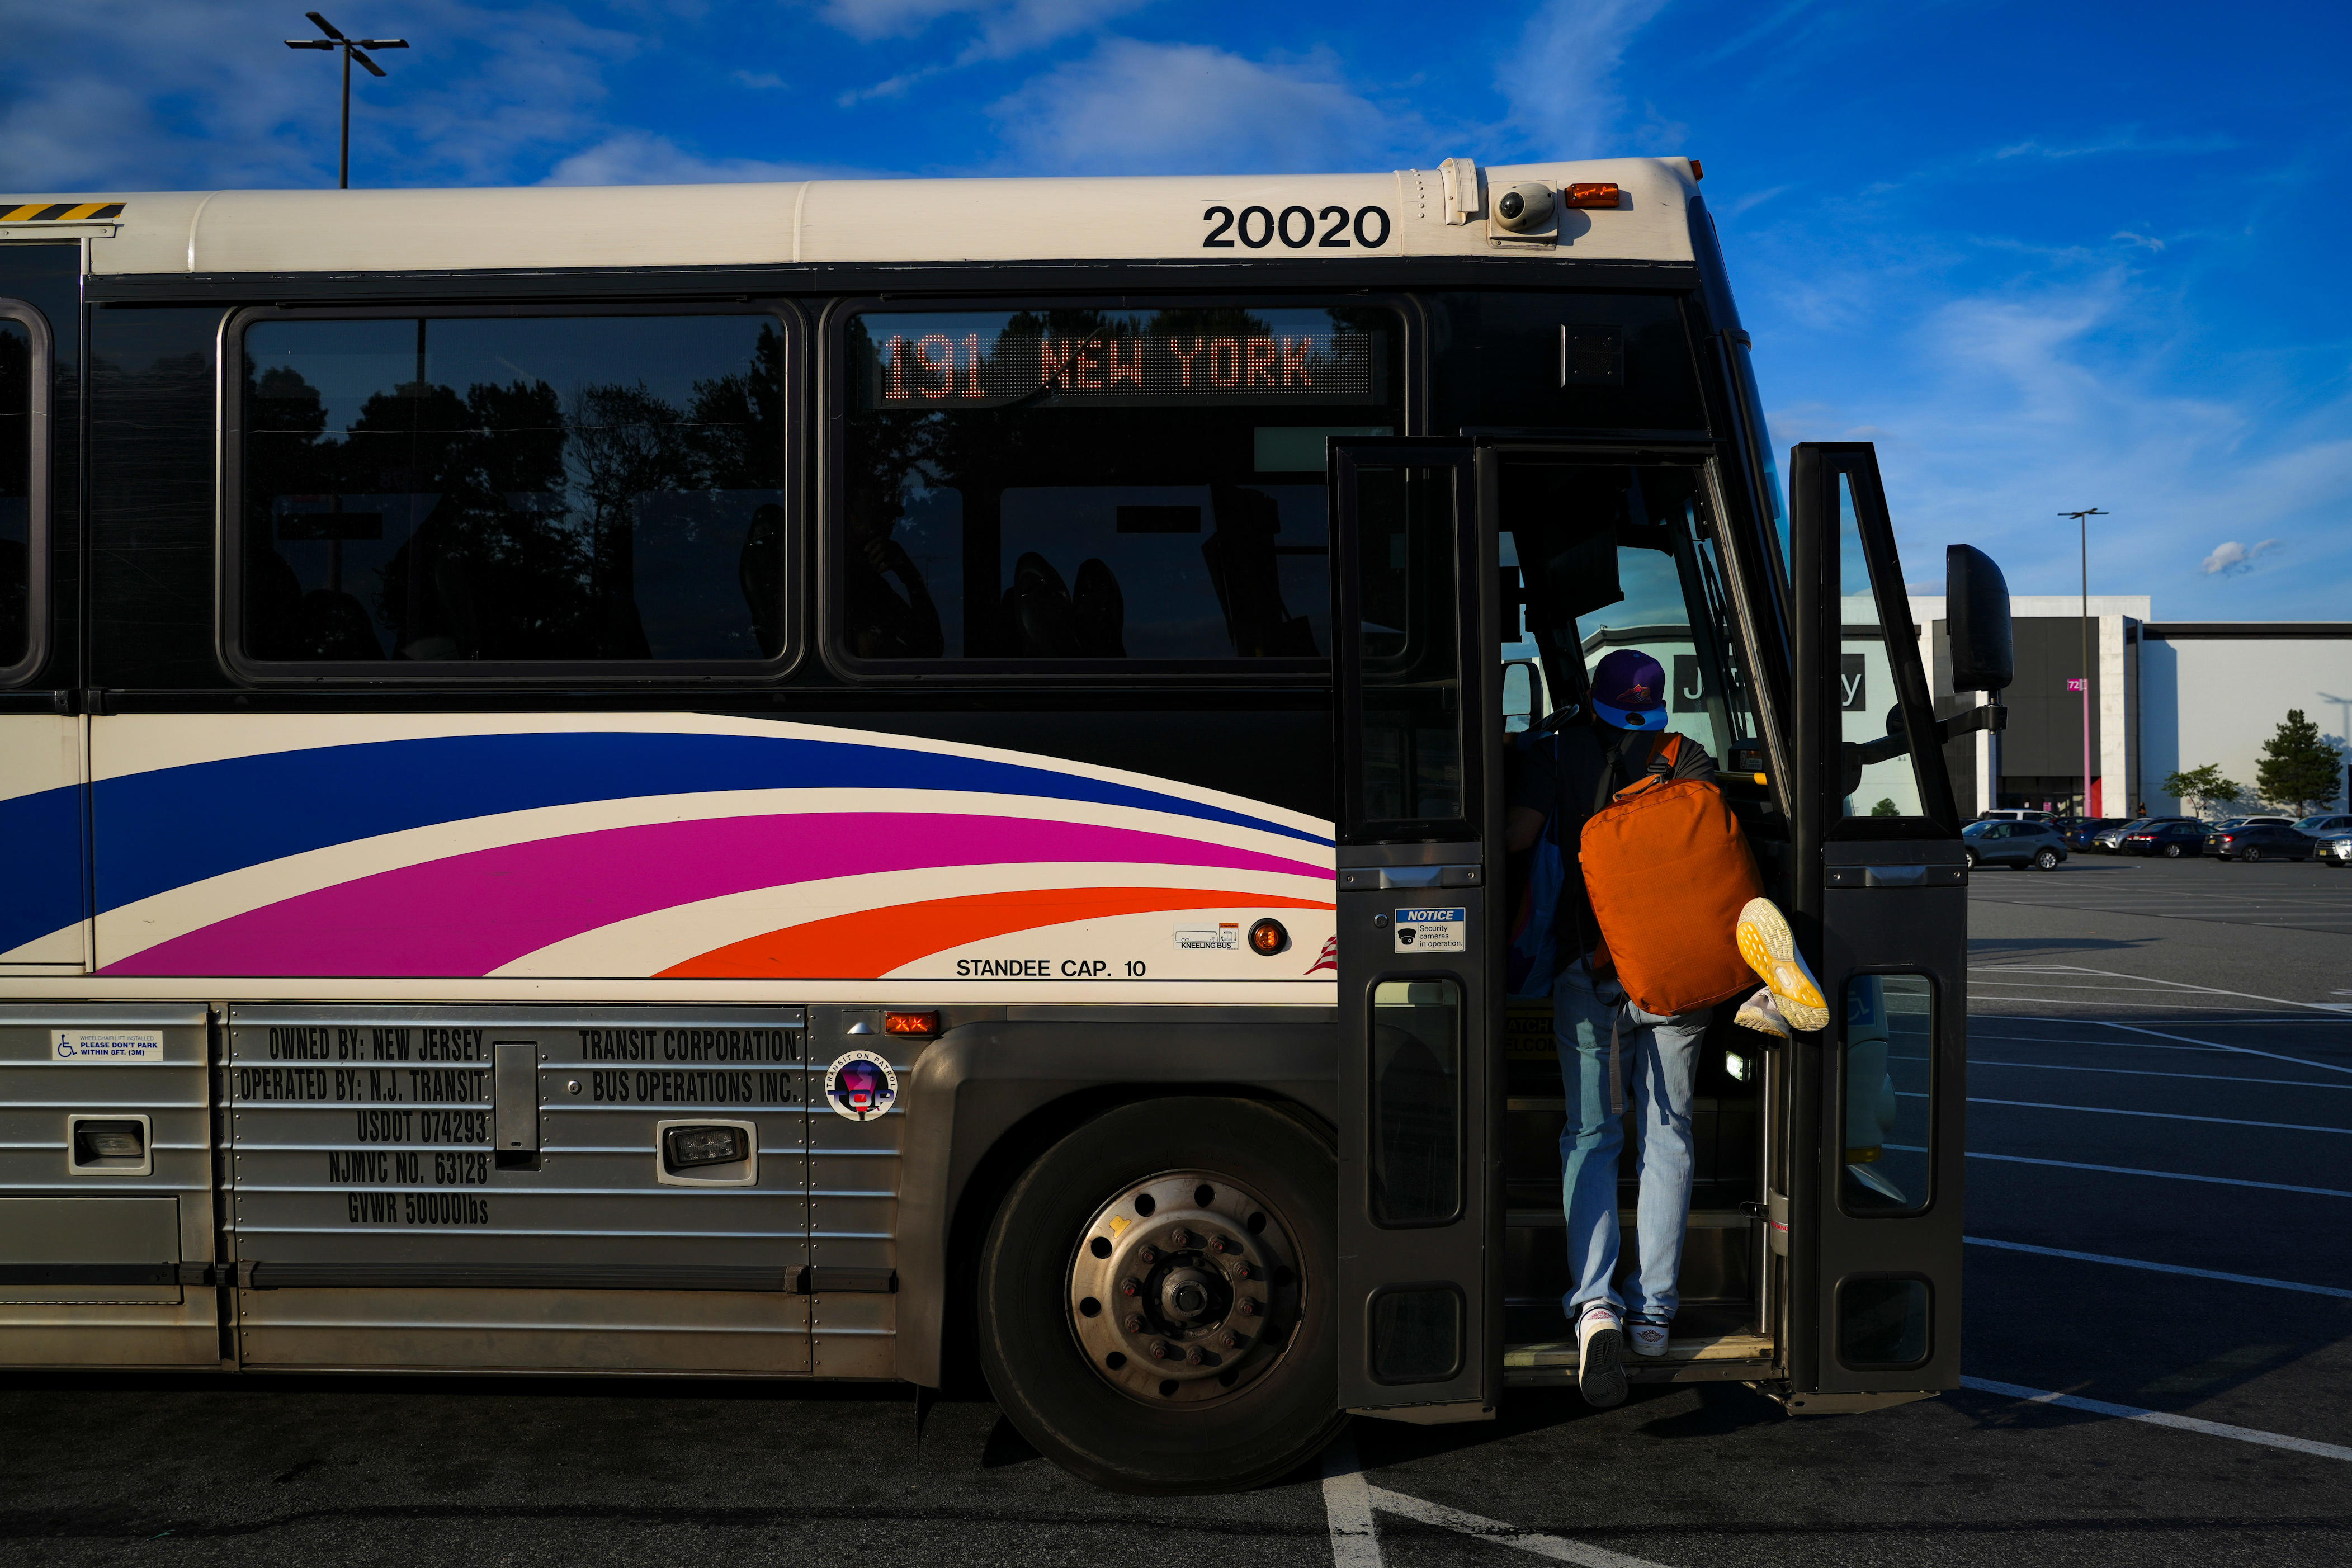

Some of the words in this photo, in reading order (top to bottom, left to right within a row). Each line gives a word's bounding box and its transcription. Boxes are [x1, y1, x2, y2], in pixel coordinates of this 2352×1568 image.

[1203, 205, 1391, 249] 20020
[885, 333, 985, 399] 191
[1041, 339, 1143, 388] NEW
[1169, 337, 1313, 388] YORK
[2068, 681, 2079, 689] 72
[1407, 910, 1454, 921] NOTICE
[1428, 940, 1463, 948] operation.
[956, 959, 1051, 976] STANDEE
[1060, 960, 1112, 977] CAP.
[1124, 960, 1146, 977] 10
[1507, 1019, 1548, 1034] ATCH
[269, 1027, 330, 1060] OWNED
[338, 1028, 365, 1060] BY:
[372, 1028, 410, 1061] NEW
[418, 1029, 483, 1061] JERSEY
[579, 1029, 656, 1061] TRANSIT
[663, 1029, 797, 1062] CORPORATION
[240, 1068, 327, 1101] OPERATED
[336, 1069, 362, 1101] BY:
[370, 1069, 403, 1102] N.J.
[409, 1070, 485, 1102] TRANSIT
[593, 1071, 630, 1102] BUS
[636, 1071, 754, 1103] OPERATIONS
[761, 1071, 798, 1103] INC.
[826, 1055, 851, 1088] TRANSIT
[873, 1057, 896, 1088] PATROL
[827, 1089, 895, 1107] TOP
[357, 1110, 413, 1143] USDOT
[421, 1111, 487, 1144] 074293
[329, 1151, 388, 1183] NJMVC
[395, 1151, 424, 1184] NO.
[434, 1152, 488, 1184] 63128
[347, 1192, 398, 1224] GVWR
[405, 1192, 488, 1225] 50000lbs
